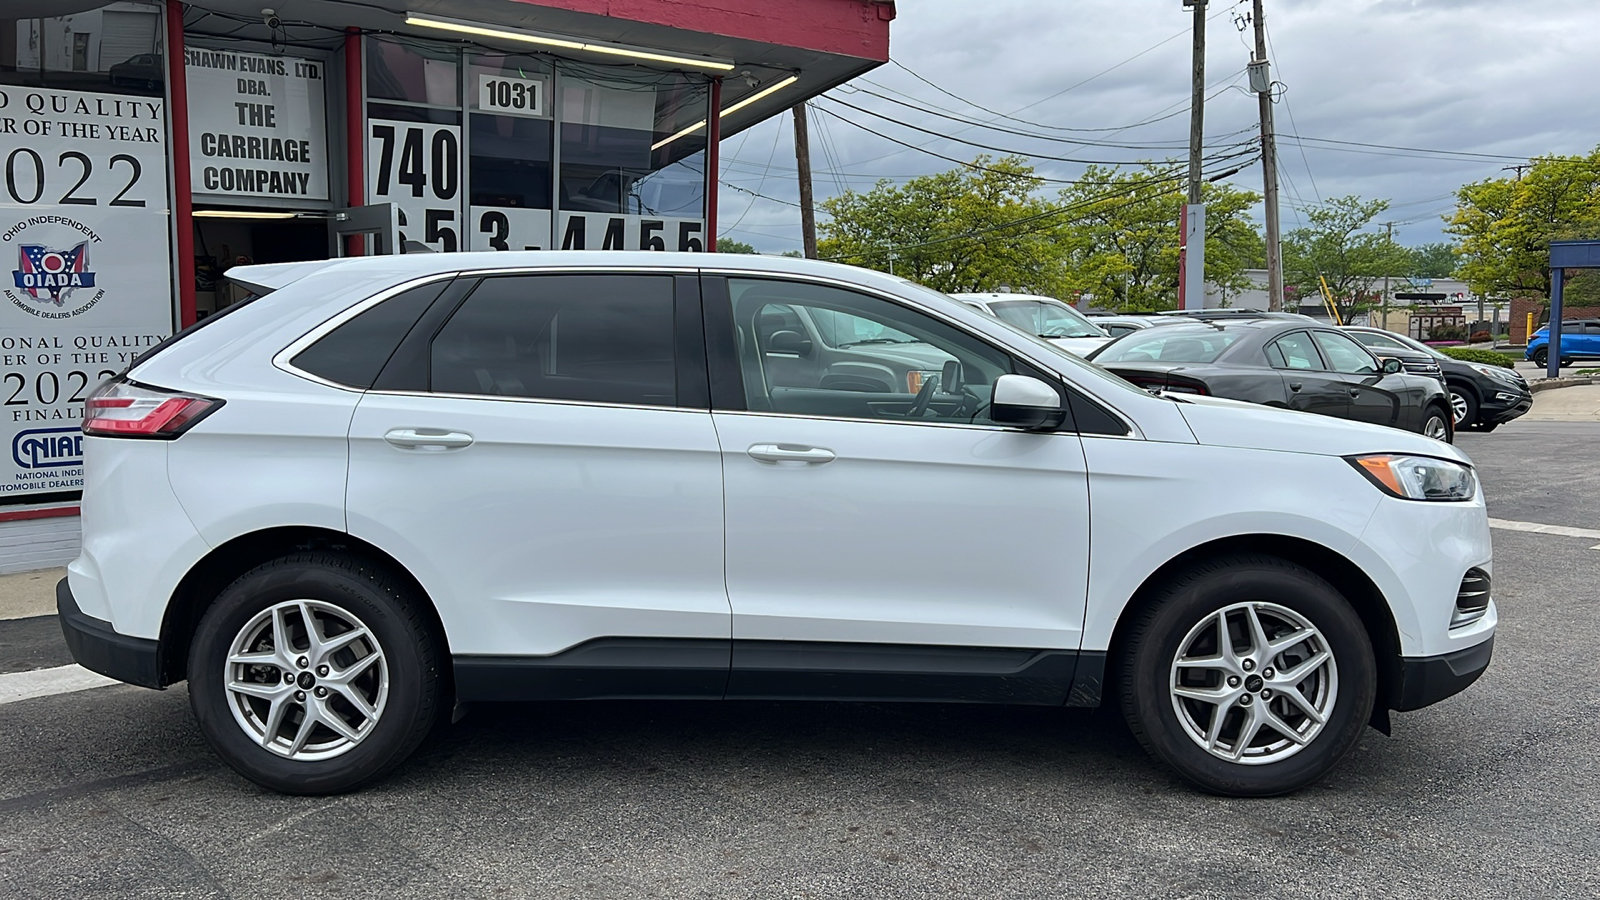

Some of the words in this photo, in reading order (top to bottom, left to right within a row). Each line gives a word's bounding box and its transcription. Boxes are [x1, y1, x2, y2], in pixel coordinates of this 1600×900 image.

[184, 50, 236, 71] SHAWN
[239, 55, 289, 76] EVANS.
[295, 62, 322, 80] LTD.
[237, 78, 271, 96] DBA.
[485, 80, 537, 110] 1031
[25, 93, 161, 120] QUALITY
[235, 102, 276, 128] THE
[23, 119, 52, 136] OF
[57, 121, 101, 139] THE
[105, 125, 160, 143] YEAR
[201, 132, 311, 163] CARRIAGE
[372, 125, 459, 200] 740
[203, 166, 310, 195] COMPANY
[2, 221, 27, 242] OHIO
[27, 215, 102, 243] INDEPENDENT
[23, 273, 82, 287] OIADA
[4, 289, 41, 317] AUTOMOBILE
[41, 312, 71, 320] DEALERS
[72, 288, 106, 317] ASSOCIATION
[1, 336, 63, 350] ONAL
[74, 335, 167, 350] QUALITY
[3, 354, 27, 366] ER
[37, 353, 61, 365] OF
[71, 352, 109, 364] THE
[0, 481, 46, 492] TOMOBILE
[15, 470, 59, 480] NATIONAL
[61, 468, 84, 478] INDE
